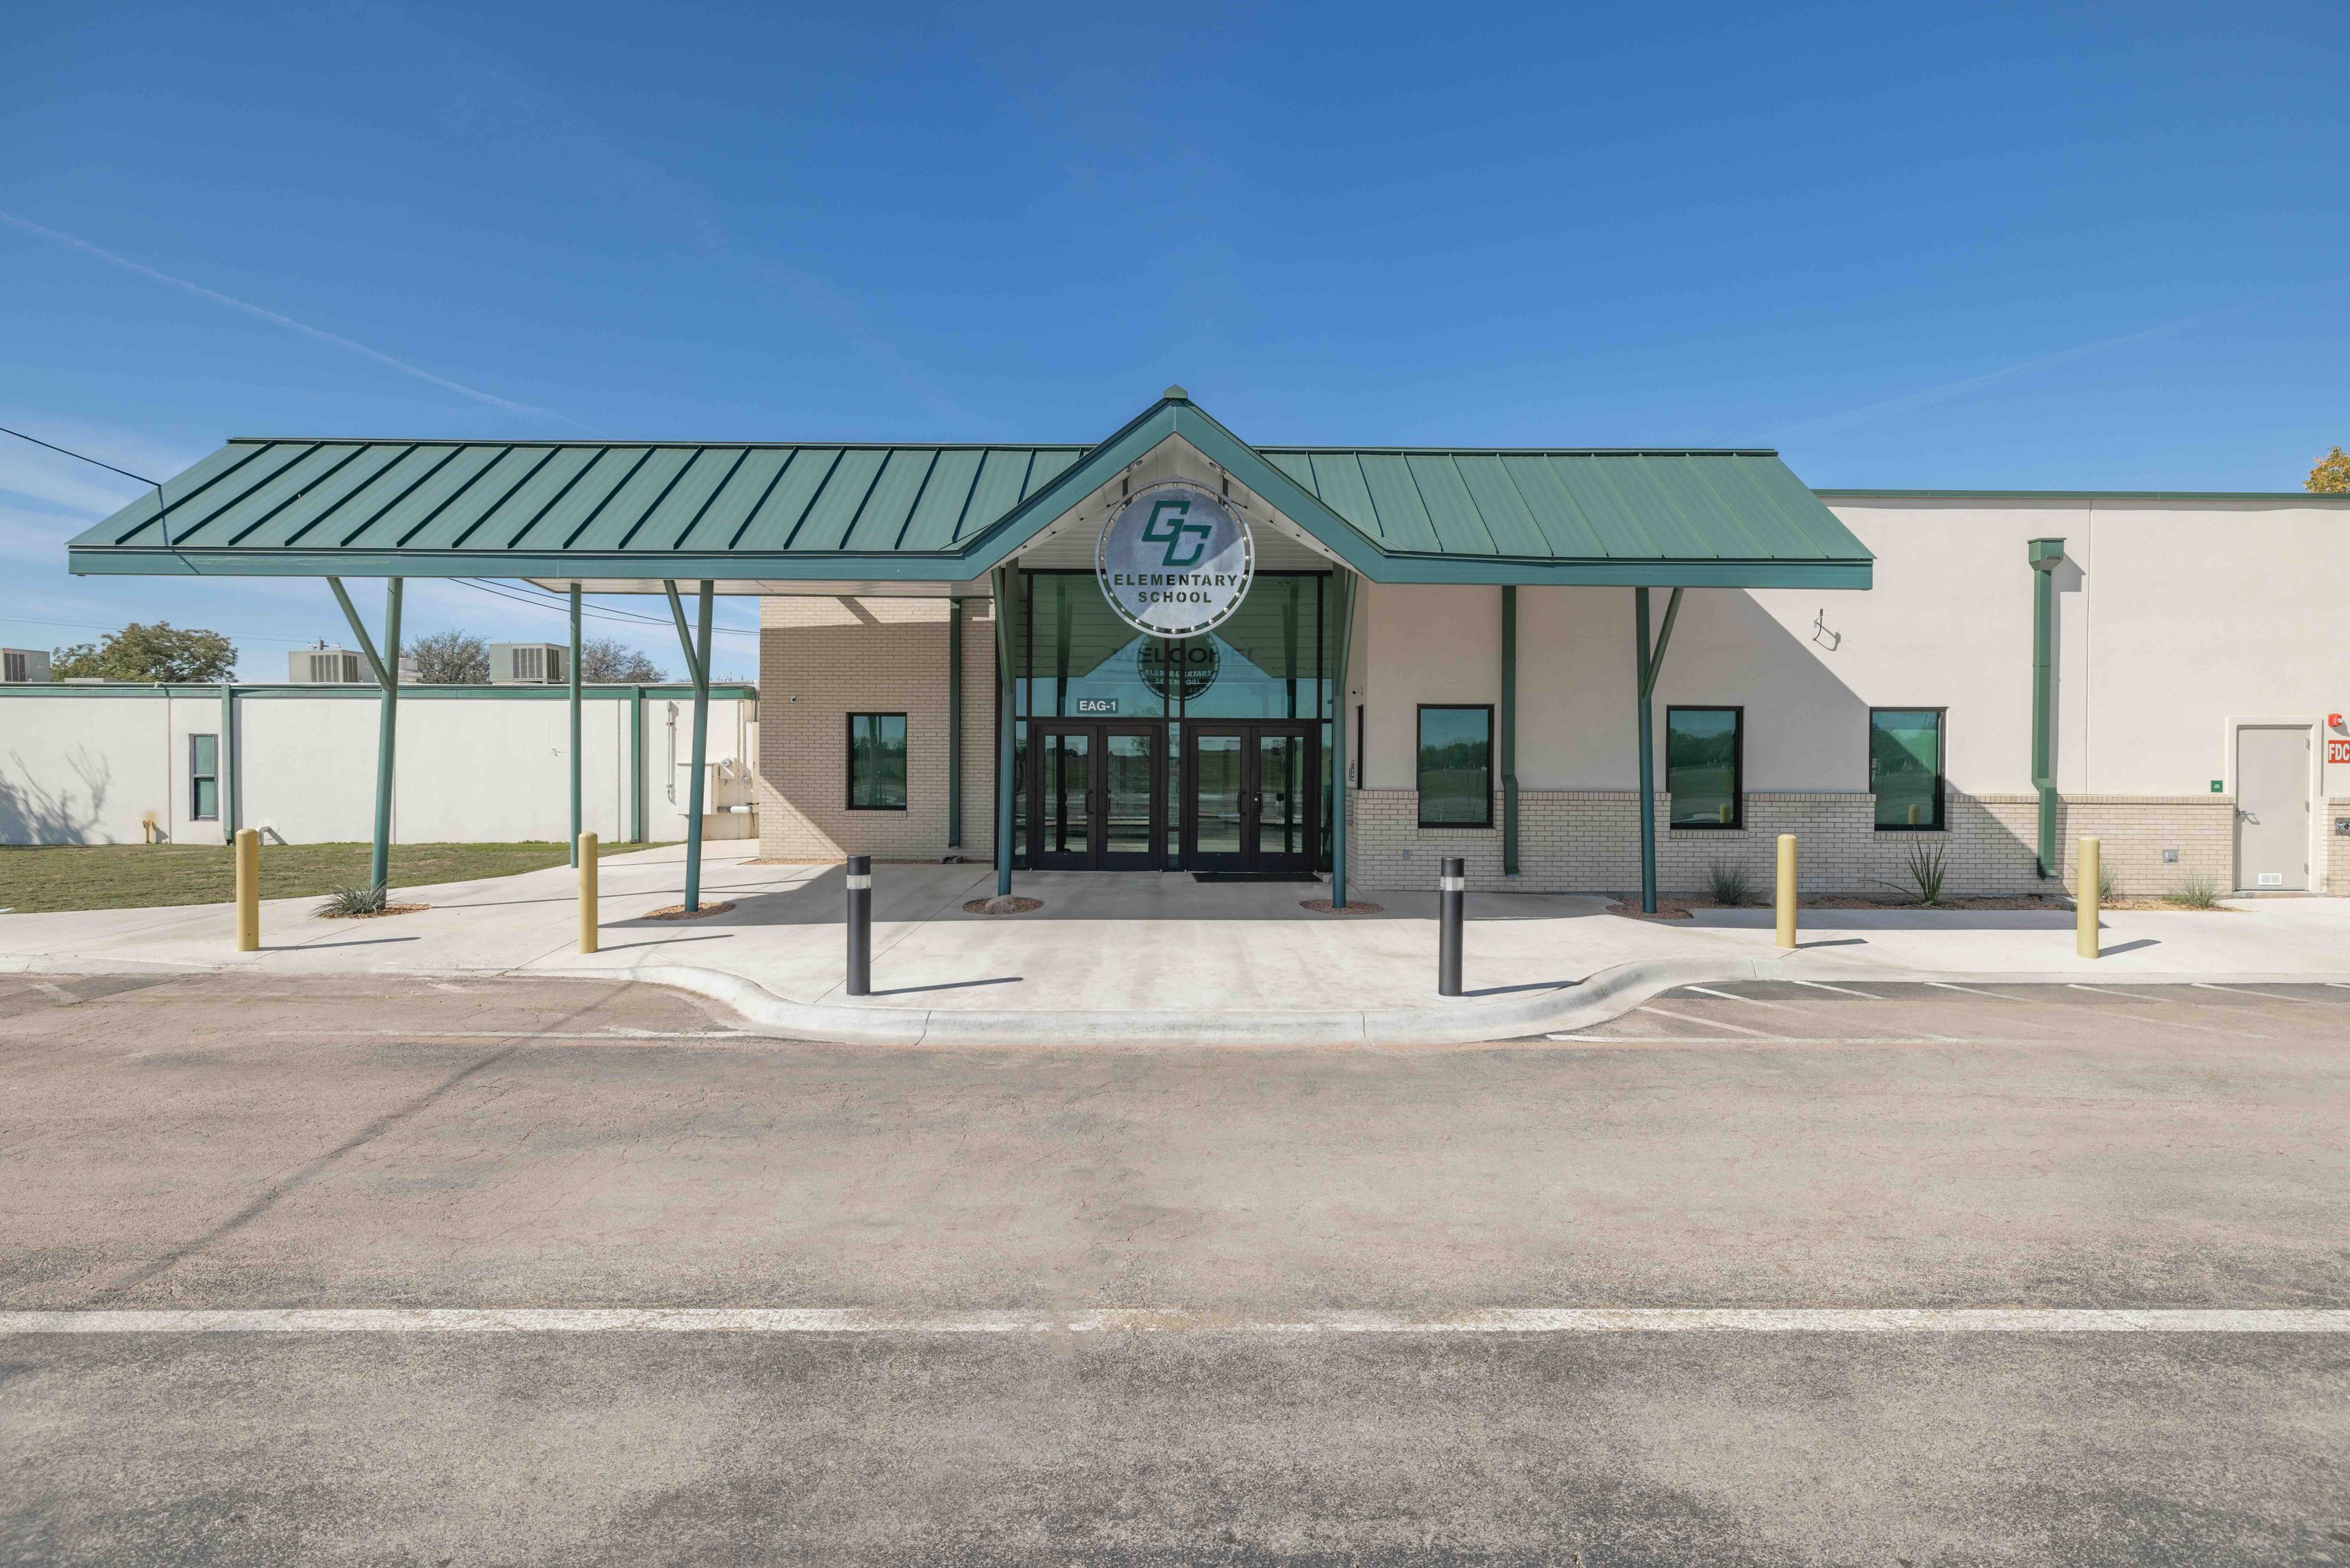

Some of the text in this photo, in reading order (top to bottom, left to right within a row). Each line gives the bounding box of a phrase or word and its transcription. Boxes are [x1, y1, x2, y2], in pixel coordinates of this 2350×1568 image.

[1113, 573, 1238, 587] ELEMENTARY
[1138, 591, 1212, 604] SCHOOL
[1079, 700, 1116, 711] EAG-1
[2329, 743, 2350, 761] FDC
